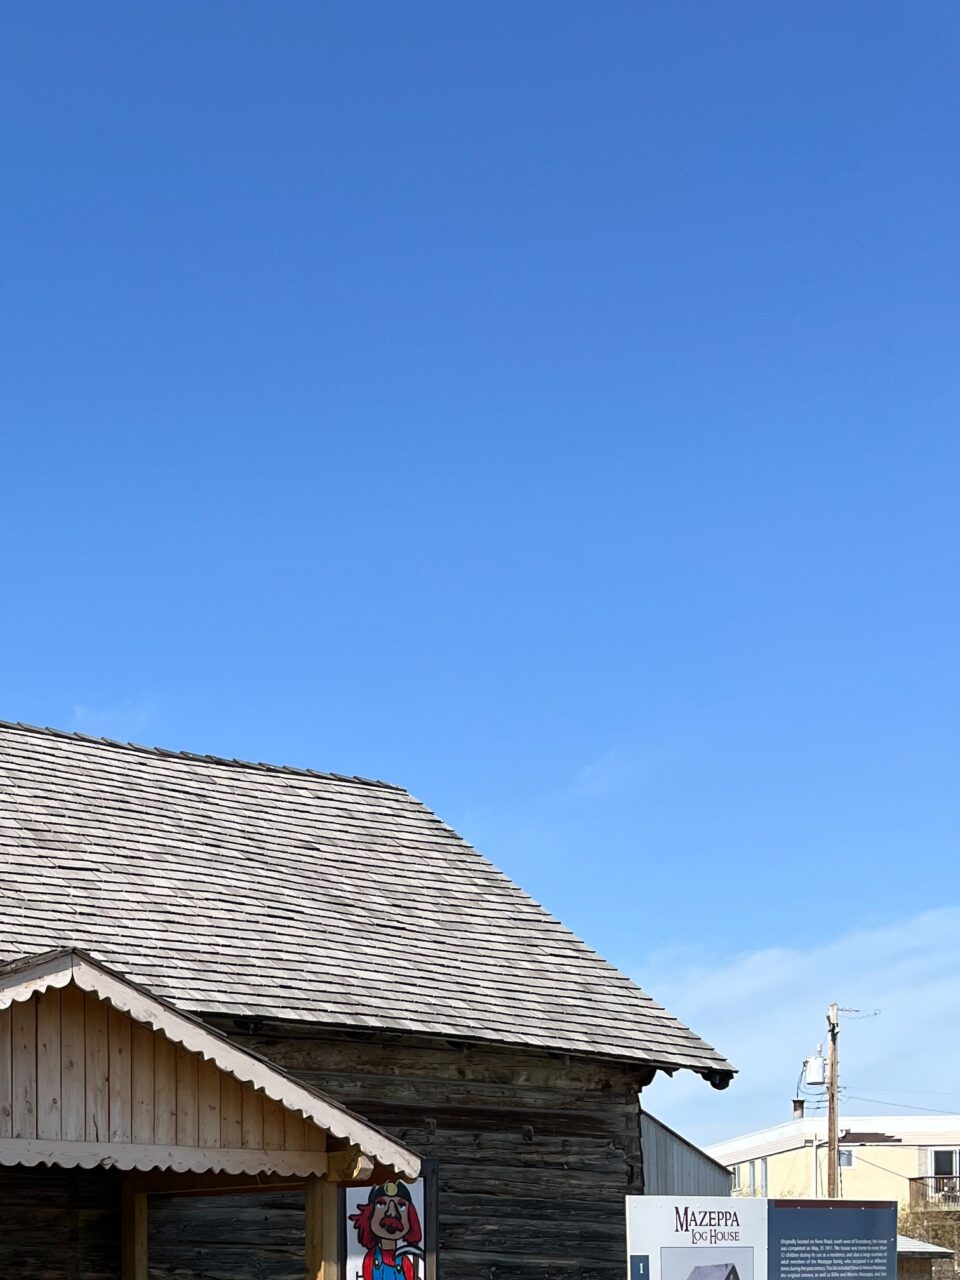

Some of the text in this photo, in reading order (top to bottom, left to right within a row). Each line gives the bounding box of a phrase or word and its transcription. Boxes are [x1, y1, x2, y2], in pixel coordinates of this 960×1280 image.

[674, 1206, 740, 1233] MAZEPPA
[691, 1228, 740, 1245] LOG HOUSE
